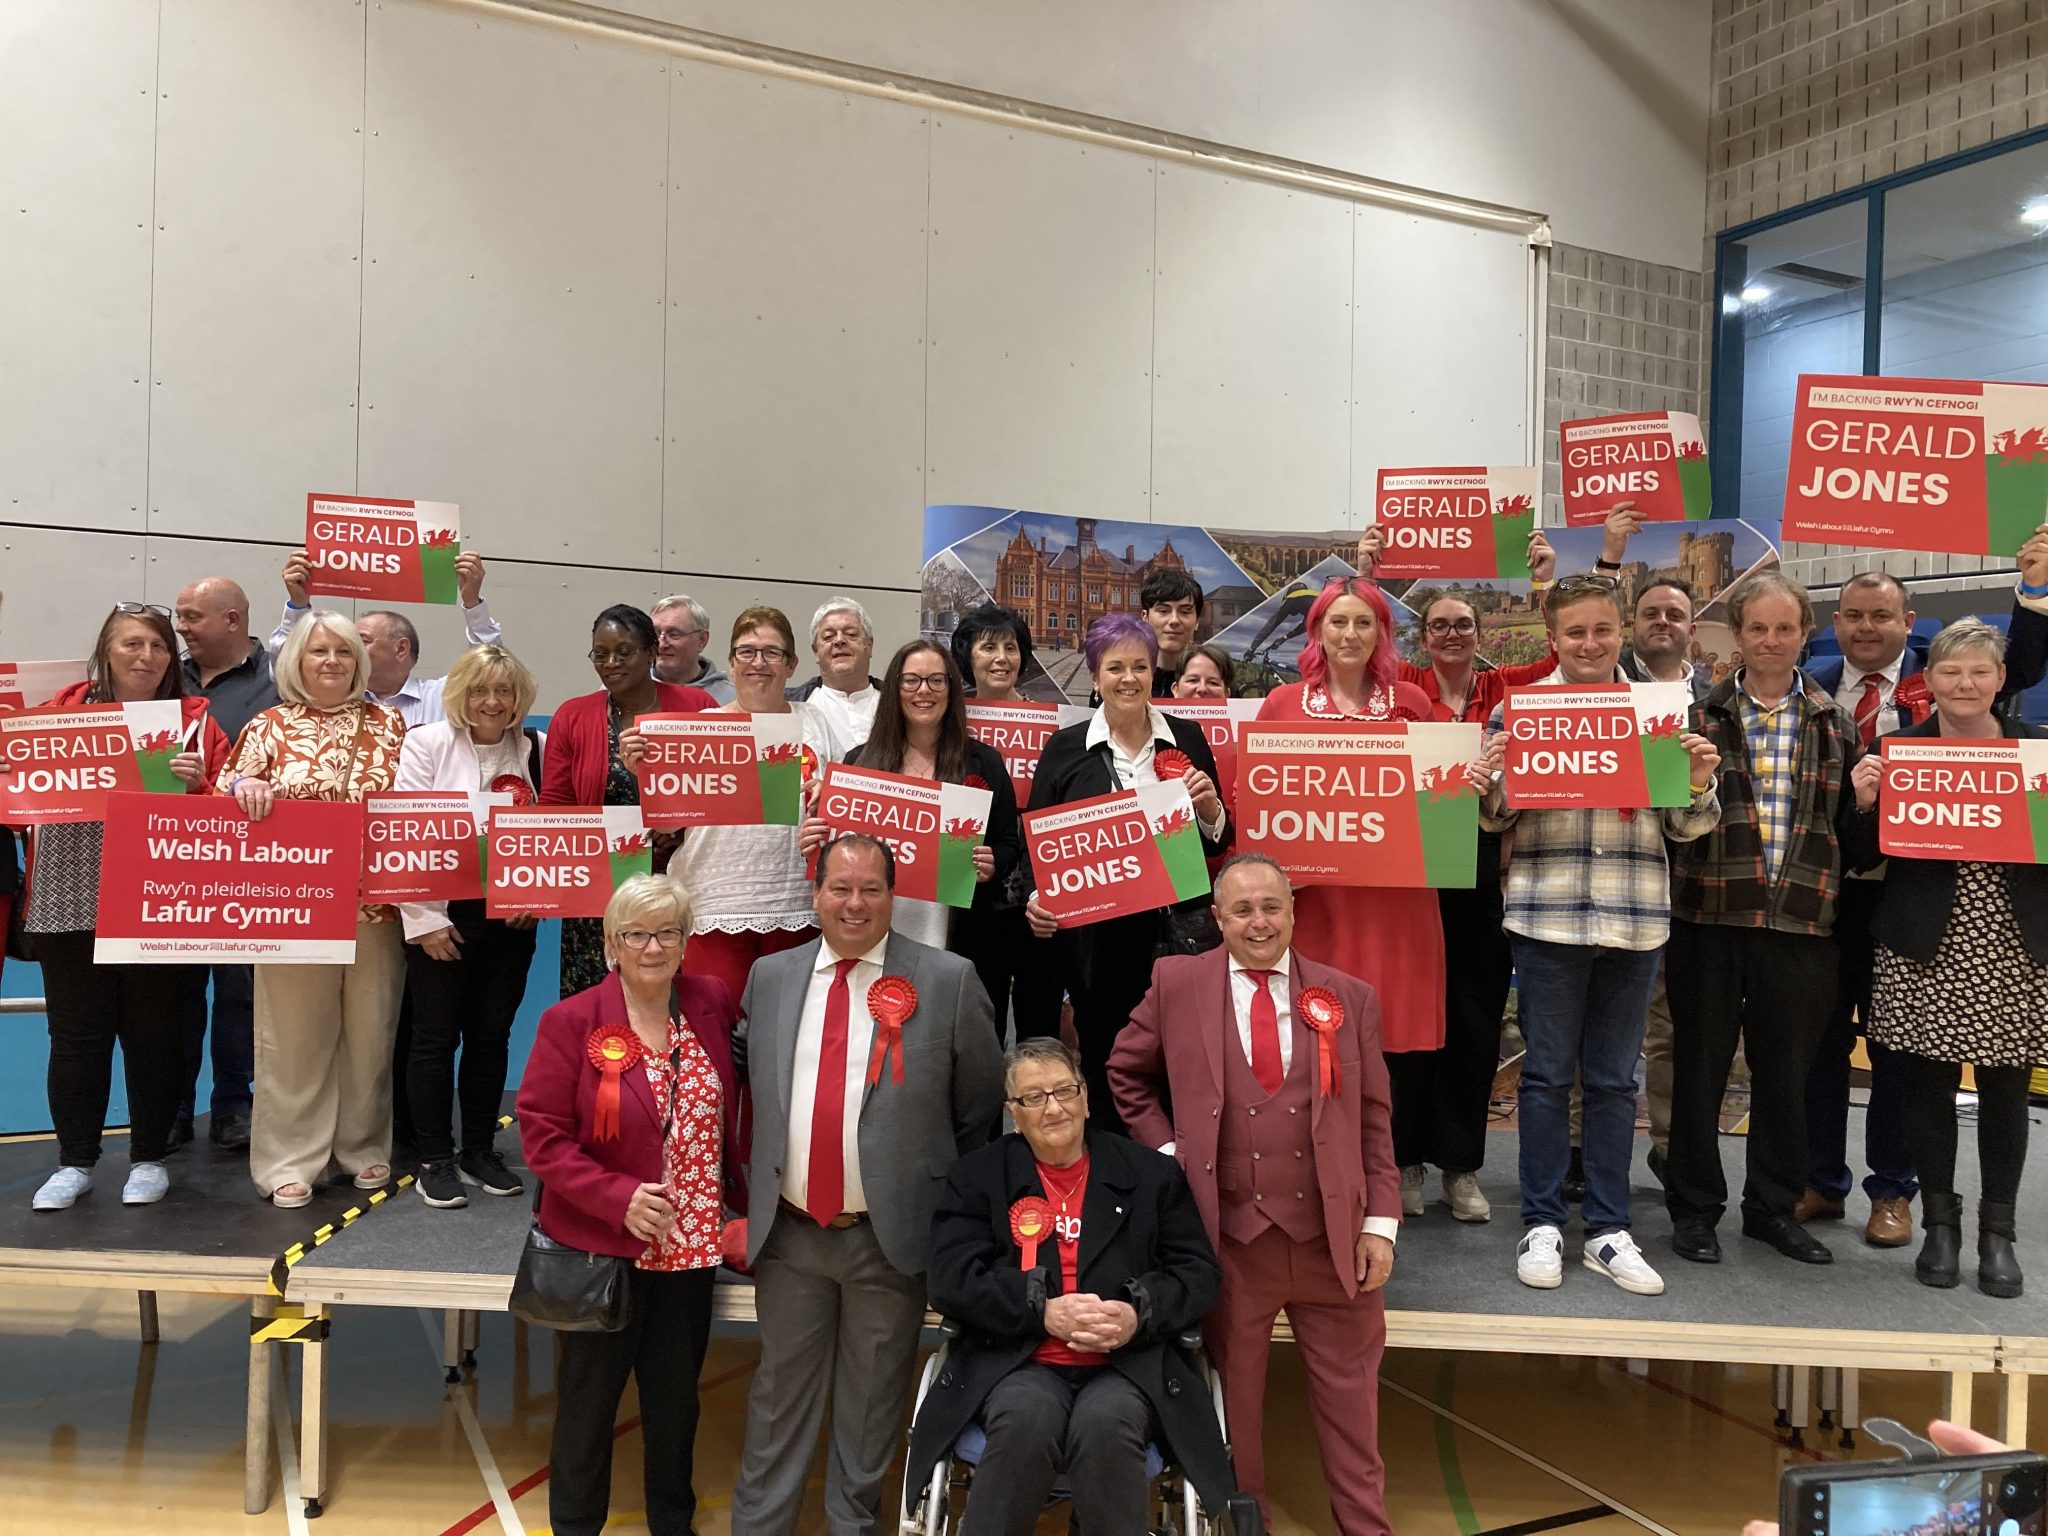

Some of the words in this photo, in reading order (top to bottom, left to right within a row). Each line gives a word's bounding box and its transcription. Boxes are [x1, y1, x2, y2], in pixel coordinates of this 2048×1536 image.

[1813, 393, 1828, 402] I'M
[1831, 393, 1882, 405] BACKING
[1884, 397, 1924, 407] RWY'N
[1926, 399, 1978, 411] CEFNOGI
[1578, 428, 1611, 437] BACKING
[1611, 425, 1636, 433] RWY'N
[1637, 423, 1668, 431] CEFNOGI
[1805, 419, 1976, 459] GERALD
[1568, 440, 1671, 468] GERALD
[1570, 470, 1659, 498] JONES
[1799, 466, 1950, 506] JONES
[326, 504, 358, 513] BACKING
[383, 509, 414, 517] CEFNOGI
[1382, 496, 1487, 518] GERALD
[313, 520, 415, 547] GERALD
[1383, 527, 1473, 549] JONES
[1796, 521, 1818, 529] Welsh
[1819, 523, 1842, 531] Labour
[1870, 527, 1894, 535] Cymru
[311, 549, 401, 574] JONES
[972, 709, 1001, 717] BACKING
[1526, 697, 1562, 705] BACKING
[1564, 696, 1592, 704] RWY'N
[1593, 696, 1630, 704] CEFNOGI
[18, 718, 55, 727] BACKING
[86, 715, 123, 723] CEFNOGI
[1512, 716, 1633, 741] GERALD
[6, 733, 127, 761] GERALD
[642, 742, 752, 765] GERALD
[1251, 738, 1265, 748] I'M
[1267, 738, 1315, 748] BACKING
[1317, 740, 1354, 749] RWY'N
[1356, 740, 1405, 749] CEFNOGI
[1977, 751, 2018, 759] CEFNOGI
[1512, 750, 1619, 775] JONES
[7, 766, 117, 794] JONES
[644, 773, 738, 796] JONES
[833, 775, 843, 783] I'M
[844, 776, 878, 790] BACKING
[879, 783, 905, 795] RWY'N
[905, 788, 939, 801] CEFNOGI
[1247, 764, 1406, 797] GERALD
[1889, 768, 2019, 794] GERALD
[148, 813, 178, 832] I'm
[184, 816, 249, 839] voting
[509, 817, 542, 825] BACKING
[543, 817, 568, 825] RWY'N
[569, 817, 603, 825] CEFNOGI
[826, 794, 936, 834] GERALD
[1033, 822, 1044, 830] I'M
[1044, 814, 1077, 828] BACKING
[1078, 808, 1104, 820] RWY'N
[1104, 801, 1138, 814] CEFNOGI
[1246, 809, 1385, 843] JONES
[1887, 801, 2002, 828] JONES
[368, 819, 472, 842] GERALD
[1037, 820, 1146, 864] GERALD
[147, 837, 232, 862] Welsh
[239, 841, 334, 865] Labour
[494, 835, 604, 857] GERALD
[368, 849, 460, 874] JONES
[494, 866, 590, 888] JONES
[1045, 855, 1142, 897] JONES
[143, 880, 195, 900] Rwy'n
[202, 881, 291, 900] pleidleisio
[295, 884, 334, 899] dros
[141, 900, 217, 924] Lafur
[222, 902, 312, 930] Cymru
[140, 943, 172, 951] Welsh
[174, 942, 210, 951] Labour
[220, 943, 247, 951] Llafur
[248, 943, 281, 954] Cymru
